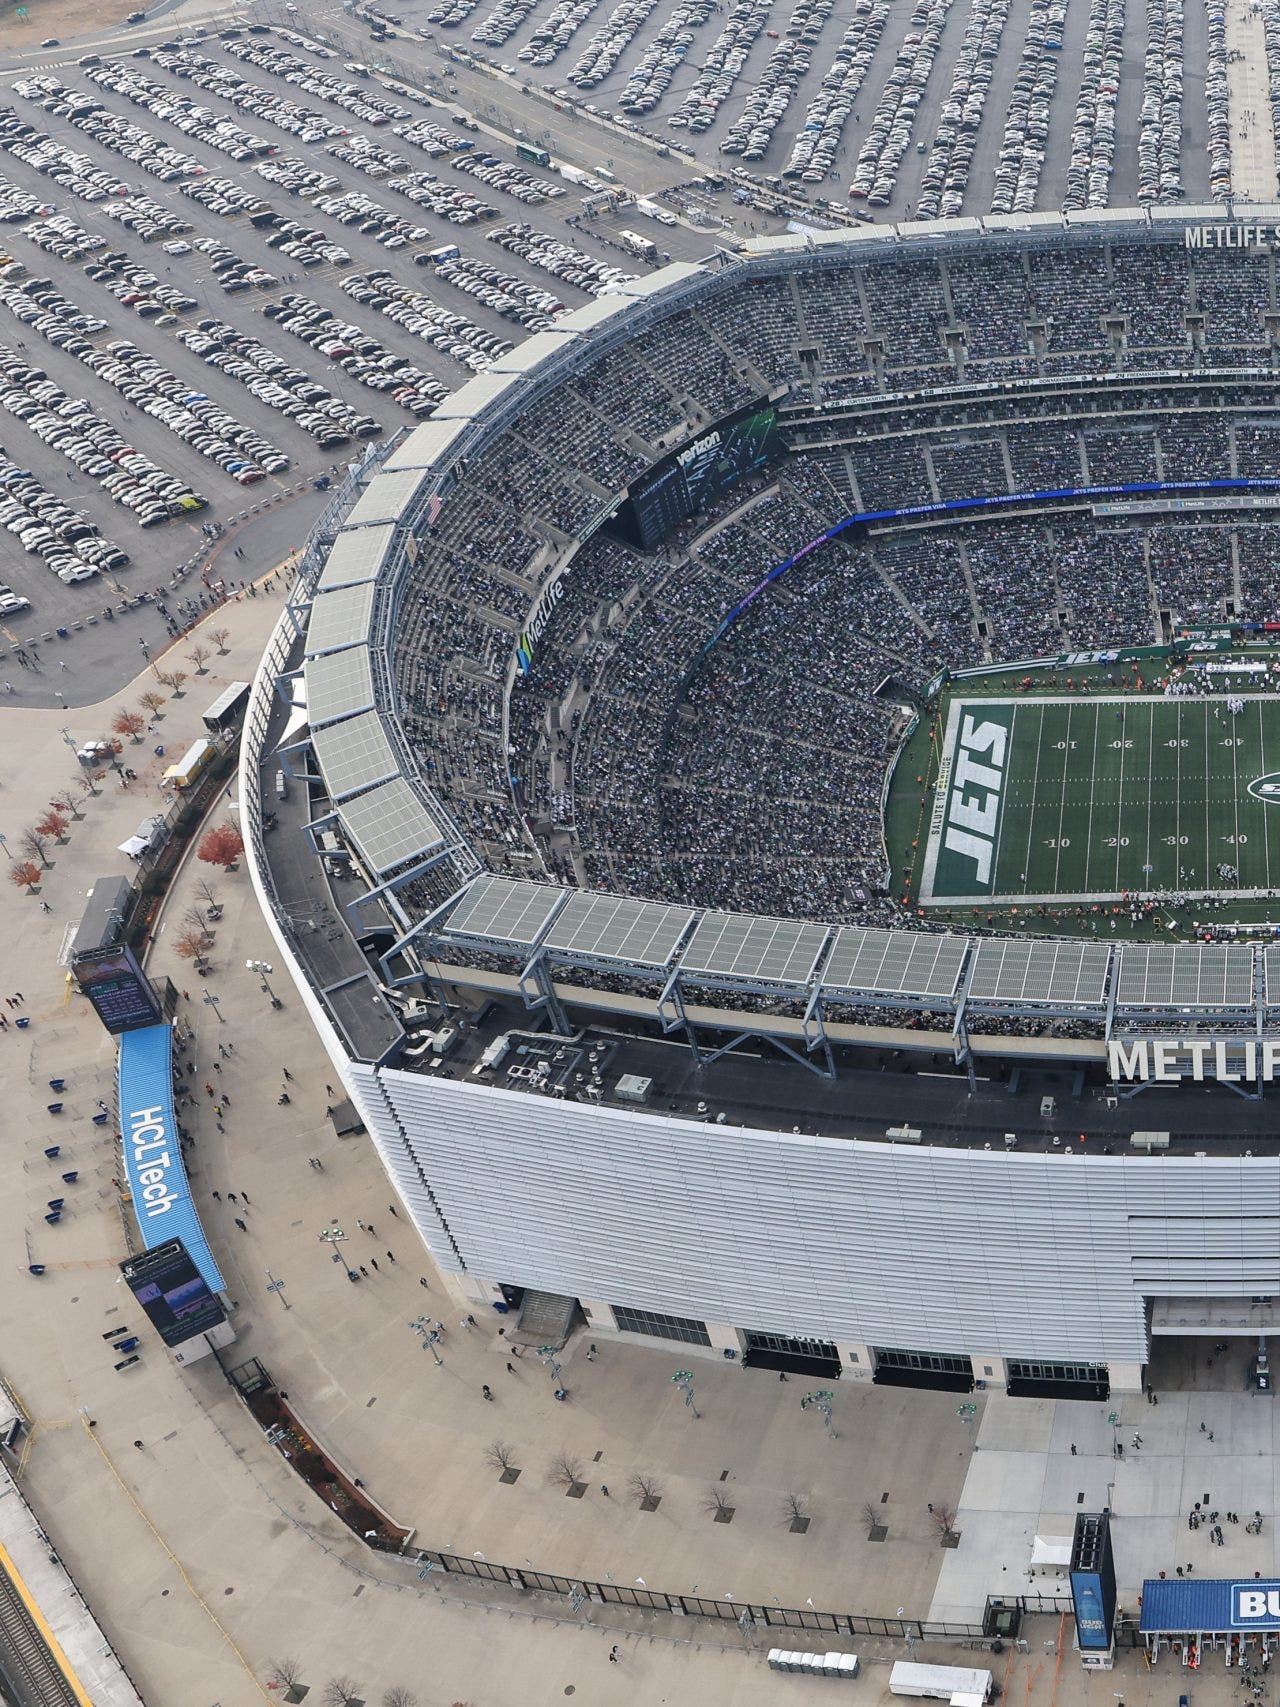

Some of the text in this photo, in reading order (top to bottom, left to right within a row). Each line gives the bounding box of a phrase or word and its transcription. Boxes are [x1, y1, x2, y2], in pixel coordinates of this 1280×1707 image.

[1185, 226, 1267, 248] METLIFE
[676, 431, 721, 467] verizon
[999, 494, 1021, 502] PREFER
[896, 503, 947, 516] JETS PREFER VISA
[524, 580, 564, 653] MetLife
[1057, 740, 1078, 750] 10
[1113, 739, 1134, 749] 20
[1168, 738, 1189, 748] 30
[1224, 737, 1245, 747] 40
[937, 791, 946, 803] TO
[945, 714, 1008, 885] JETS
[931, 803, 945, 836] SALUTE
[1048, 838, 1071, 848] 10
[1107, 836, 1130, 847] 20
[1166, 836, 1189, 846] 30
[1226, 834, 1248, 844] 40
[130, 1105, 179, 1217] HCLTech
